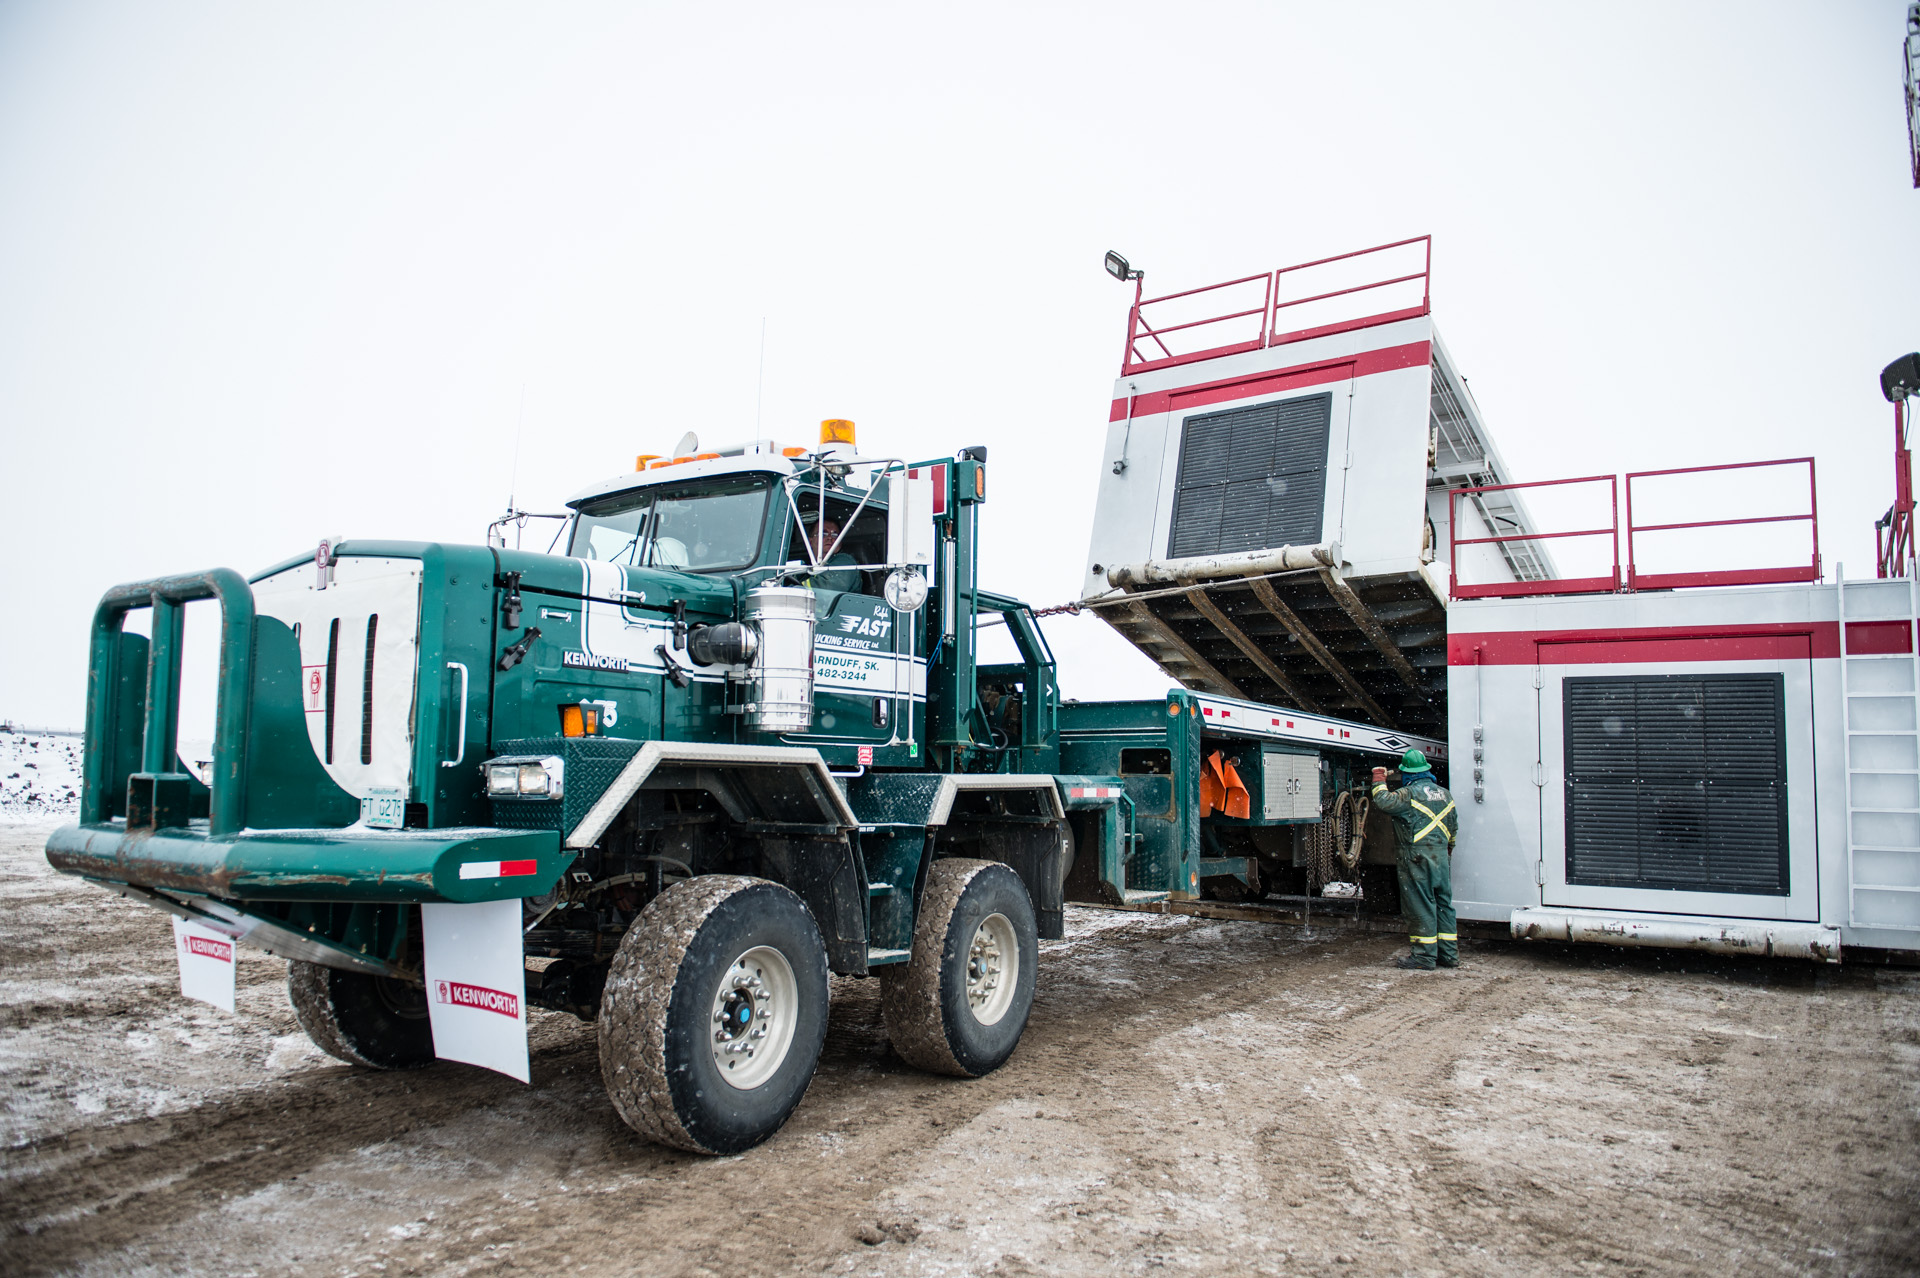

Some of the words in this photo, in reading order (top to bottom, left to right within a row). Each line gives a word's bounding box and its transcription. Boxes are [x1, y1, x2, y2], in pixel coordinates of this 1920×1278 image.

[837, 615, 892, 638] FAST
[814, 633, 843, 645] UCKING
[843, 638, 871, 649] SERVICE
[564, 651, 629, 670] KENWORTH
[864, 661, 880, 671] SK.
[817, 668, 867, 681] 482-3244
[453, 986, 517, 1015] KENWORTH
